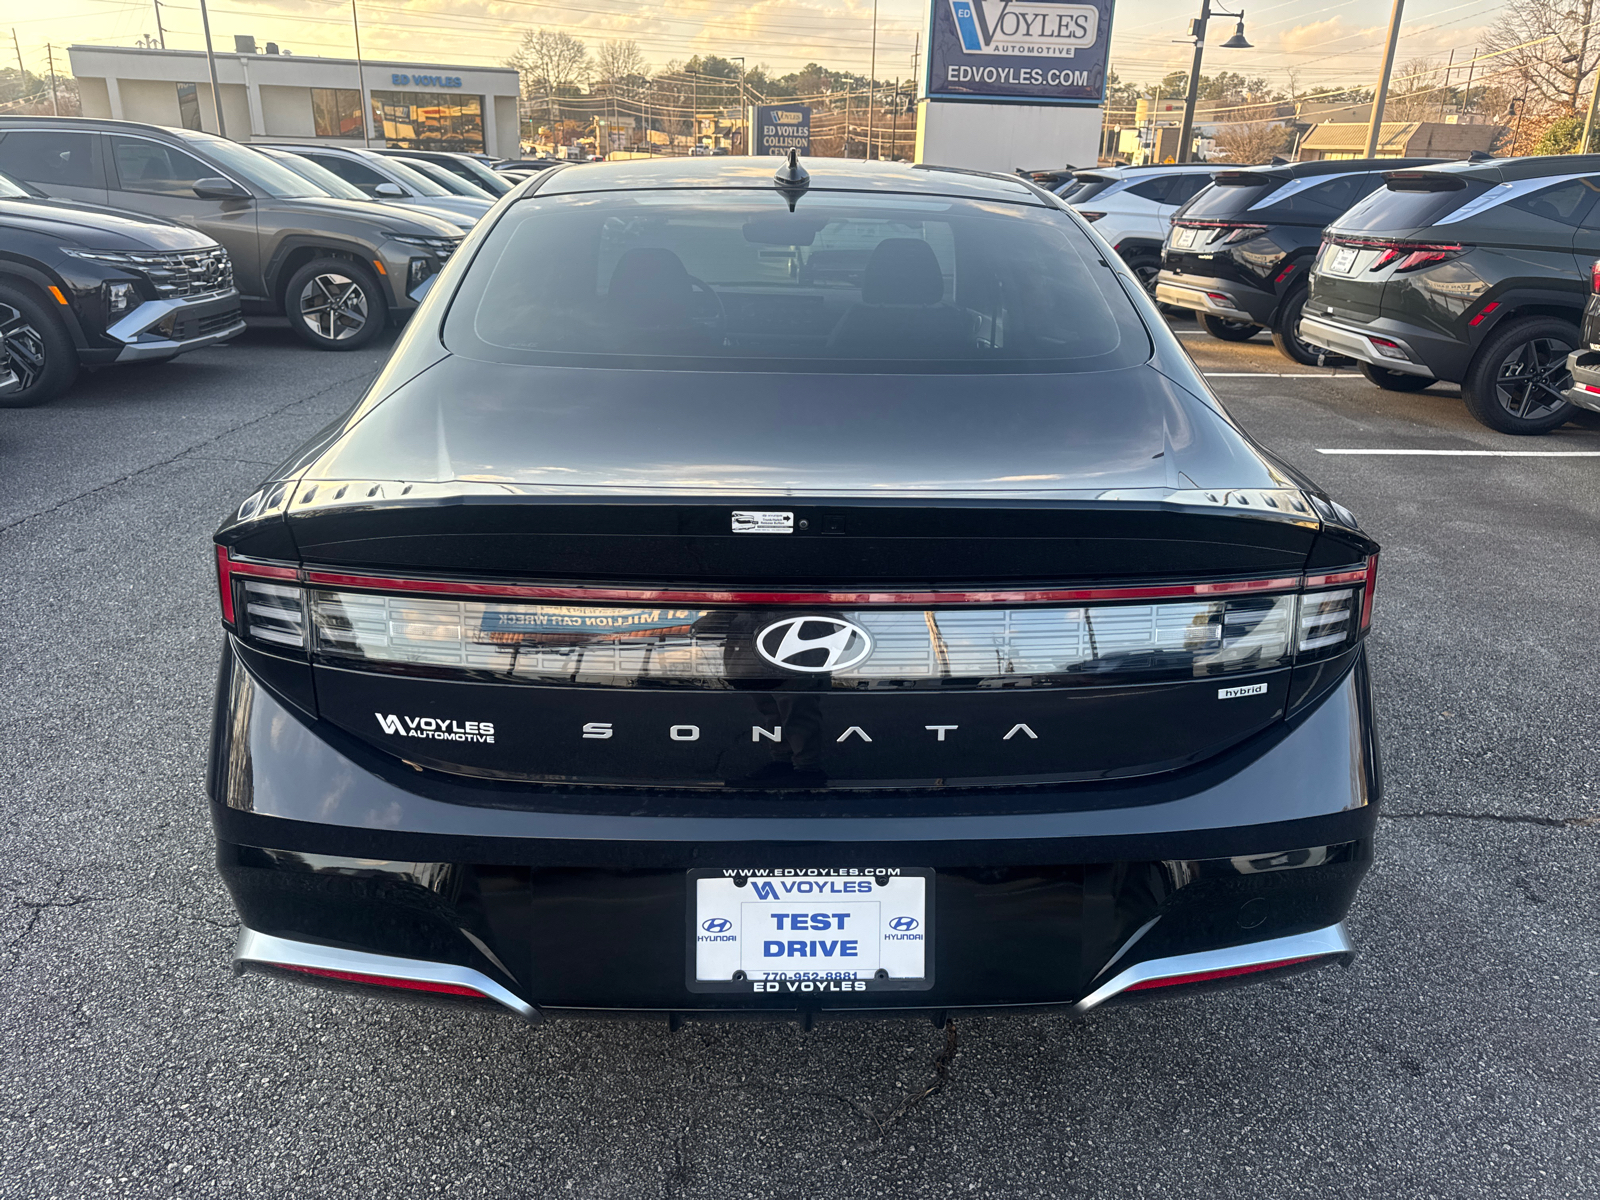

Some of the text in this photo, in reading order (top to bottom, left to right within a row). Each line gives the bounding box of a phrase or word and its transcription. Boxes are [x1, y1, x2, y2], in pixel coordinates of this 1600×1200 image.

[958, 9, 970, 18] ED
[974, 0, 1088, 46] VOYLES
[993, 45, 1073, 55] AUTOMOTIVE
[392, 74, 463, 88] ED VOYLES
[948, 65, 1088, 87] EDVOYLES.COM
[764, 126, 809, 137] ED VOYLES
[763, 136, 808, 147] COLLISION
[769, 147, 802, 156] CENTR
[1225, 686, 1262, 697] hybrid
[404, 716, 495, 735] VOYLES
[408, 729, 495, 743] AUTOMOTIVE
[723, 868, 901, 876] WWW.EDVOYLES.COM
[780, 881, 873, 894] VOYLES
[771, 913, 851, 930] TEST
[763, 940, 858, 957] DRIVE
[762, 972, 858, 980] 770-952-8881
[753, 981, 867, 992] ED VOYLES
